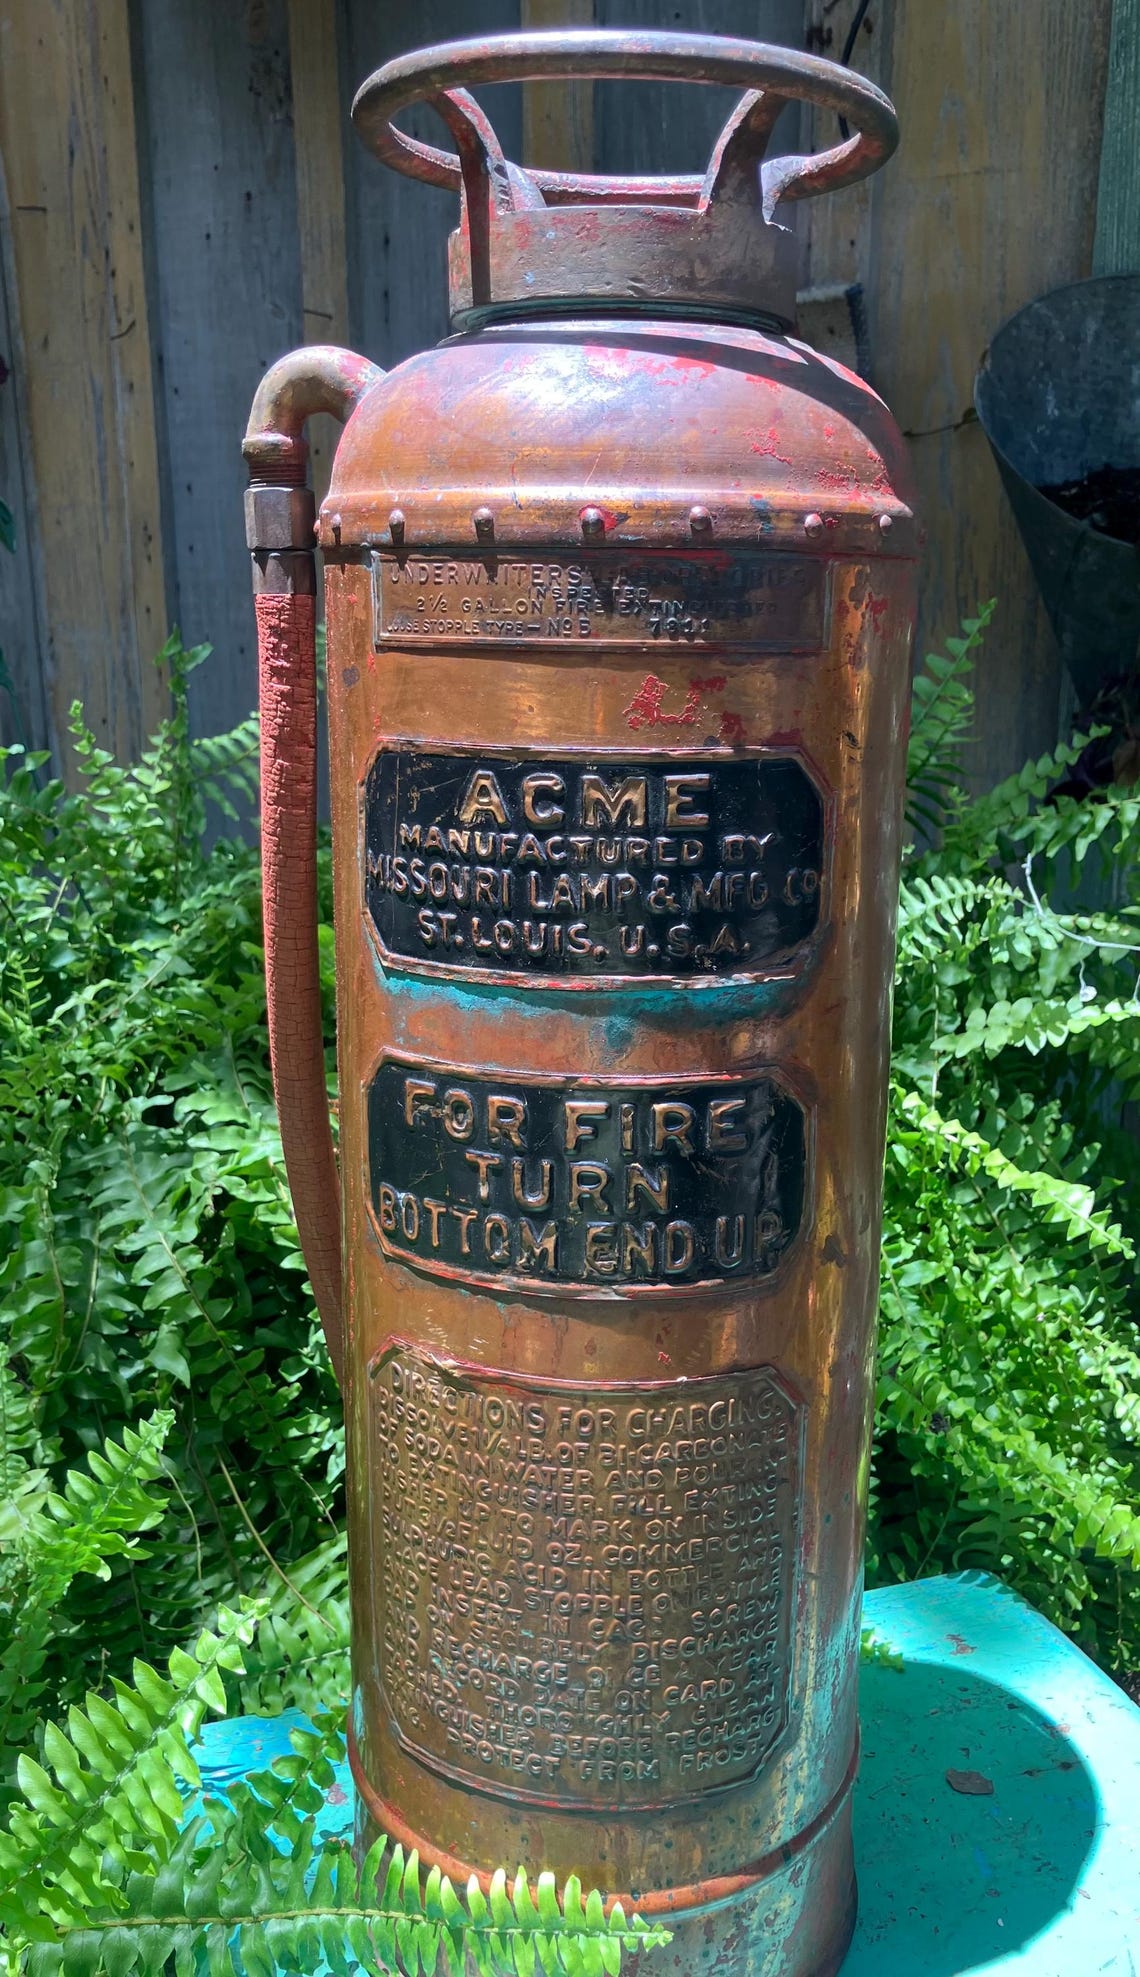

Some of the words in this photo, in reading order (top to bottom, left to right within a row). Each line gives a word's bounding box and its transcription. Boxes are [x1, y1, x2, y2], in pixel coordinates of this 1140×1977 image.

[460, 595, 543, 616] GALLON
[555, 599, 605, 617] FIRE
[528, 585, 649, 599] INSPECTED
[422, 618, 481, 634] STOPPLE
[486, 618, 524, 635] TYPE
[459, 769, 711, 831] ACME
[399, 823, 704, 866] MANUFACTURED
[721, 832, 776, 864] BY
[367, 850, 512, 913] MISSOURI
[529, 870, 638, 915] LAMP
[646, 872, 680, 914] &
[690, 869, 770, 913] MFG
[418, 908, 465, 948] ST.
[404, 1078, 528, 1152] FOR
[563, 1098, 749, 1158] FIRE
[464, 1148, 672, 1216] TURN
[379, 1181, 560, 1277] BOTTOM
[584, 1219, 695, 1278] END
[713, 1208, 786, 1270] UP
[379, 1385, 468, 1448] DISSOLVE
[556, 1441, 590, 1465] OF
[390, 1360, 546, 1437] DIRECTIONS
[557, 1405, 618, 1437] FOR
[379, 1411, 399, 1438] OF
[404, 1426, 459, 1469] SODA
[465, 1449, 490, 1480] IN
[499, 1458, 595, 1496] WATER
[604, 1469, 664, 1492] AND
[458, 1497, 491, 1523] UP
[500, 1508, 535, 1536] TO
[545, 1516, 634, 1541] MARK
[645, 1519, 683, 1540] ON
[693, 1498, 777, 1536] INSIDE
[458, 1520, 534, 1560] FLUID
[545, 1542, 594, 1567] OZ.
[601, 1530, 781, 1567] COMMERCIAL
[449, 1564, 513, 1607] LEAD
[523, 1587, 643, 1619] STOPPLE
[502, 1559, 568, 1591] ACID
[582, 1569, 612, 1592] IN
[627, 1561, 724, 1593] BOTTLE
[737, 1546, 783, 1575] AND
[430, 1582, 523, 1631] INSERT
[541, 1614, 571, 1639] IN
[691, 1590, 780, 1634] SCREW
[431, 1627, 569, 1688] RECHARGE
[705, 1639, 777, 1676] YEAR
[631, 1613, 780, 1664] DISCHARGE
[484, 1694, 671, 1734] THOROGHLY
[690, 1684, 776, 1727] CLEAN
[533, 1683, 601, 1710] DATE
[614, 1689, 652, 1712] ON
[662, 1678, 736, 1707] CARD
[447, 1726, 560, 1780] PROTECT
[580, 1759, 661, 1781] FROM
[549, 1732, 655, 1760] BEFORE
